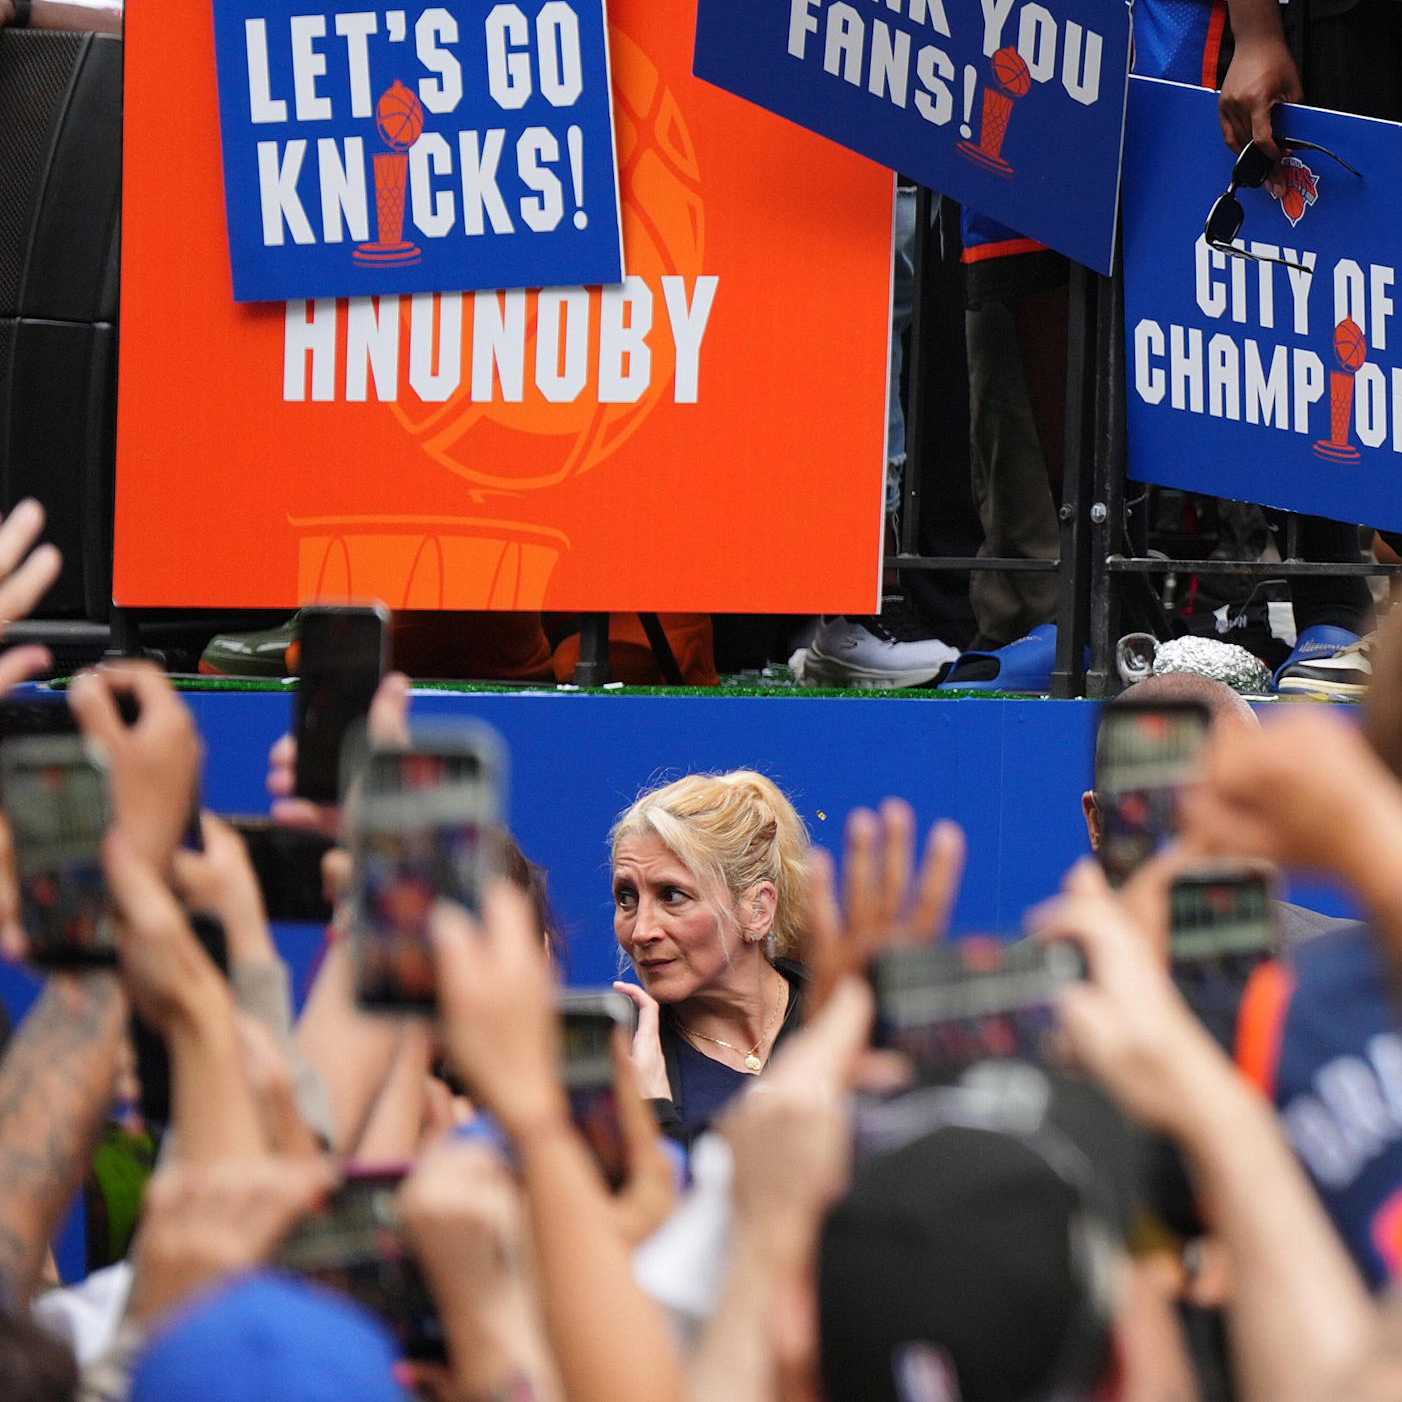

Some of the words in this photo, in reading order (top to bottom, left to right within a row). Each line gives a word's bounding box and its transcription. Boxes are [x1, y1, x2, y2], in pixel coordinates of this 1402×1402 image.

[245, 8, 463, 124] LET'S
[485, 1, 583, 110] GO
[1195, 232, 1317, 335] CITY
[1333, 259, 1395, 350] OF
